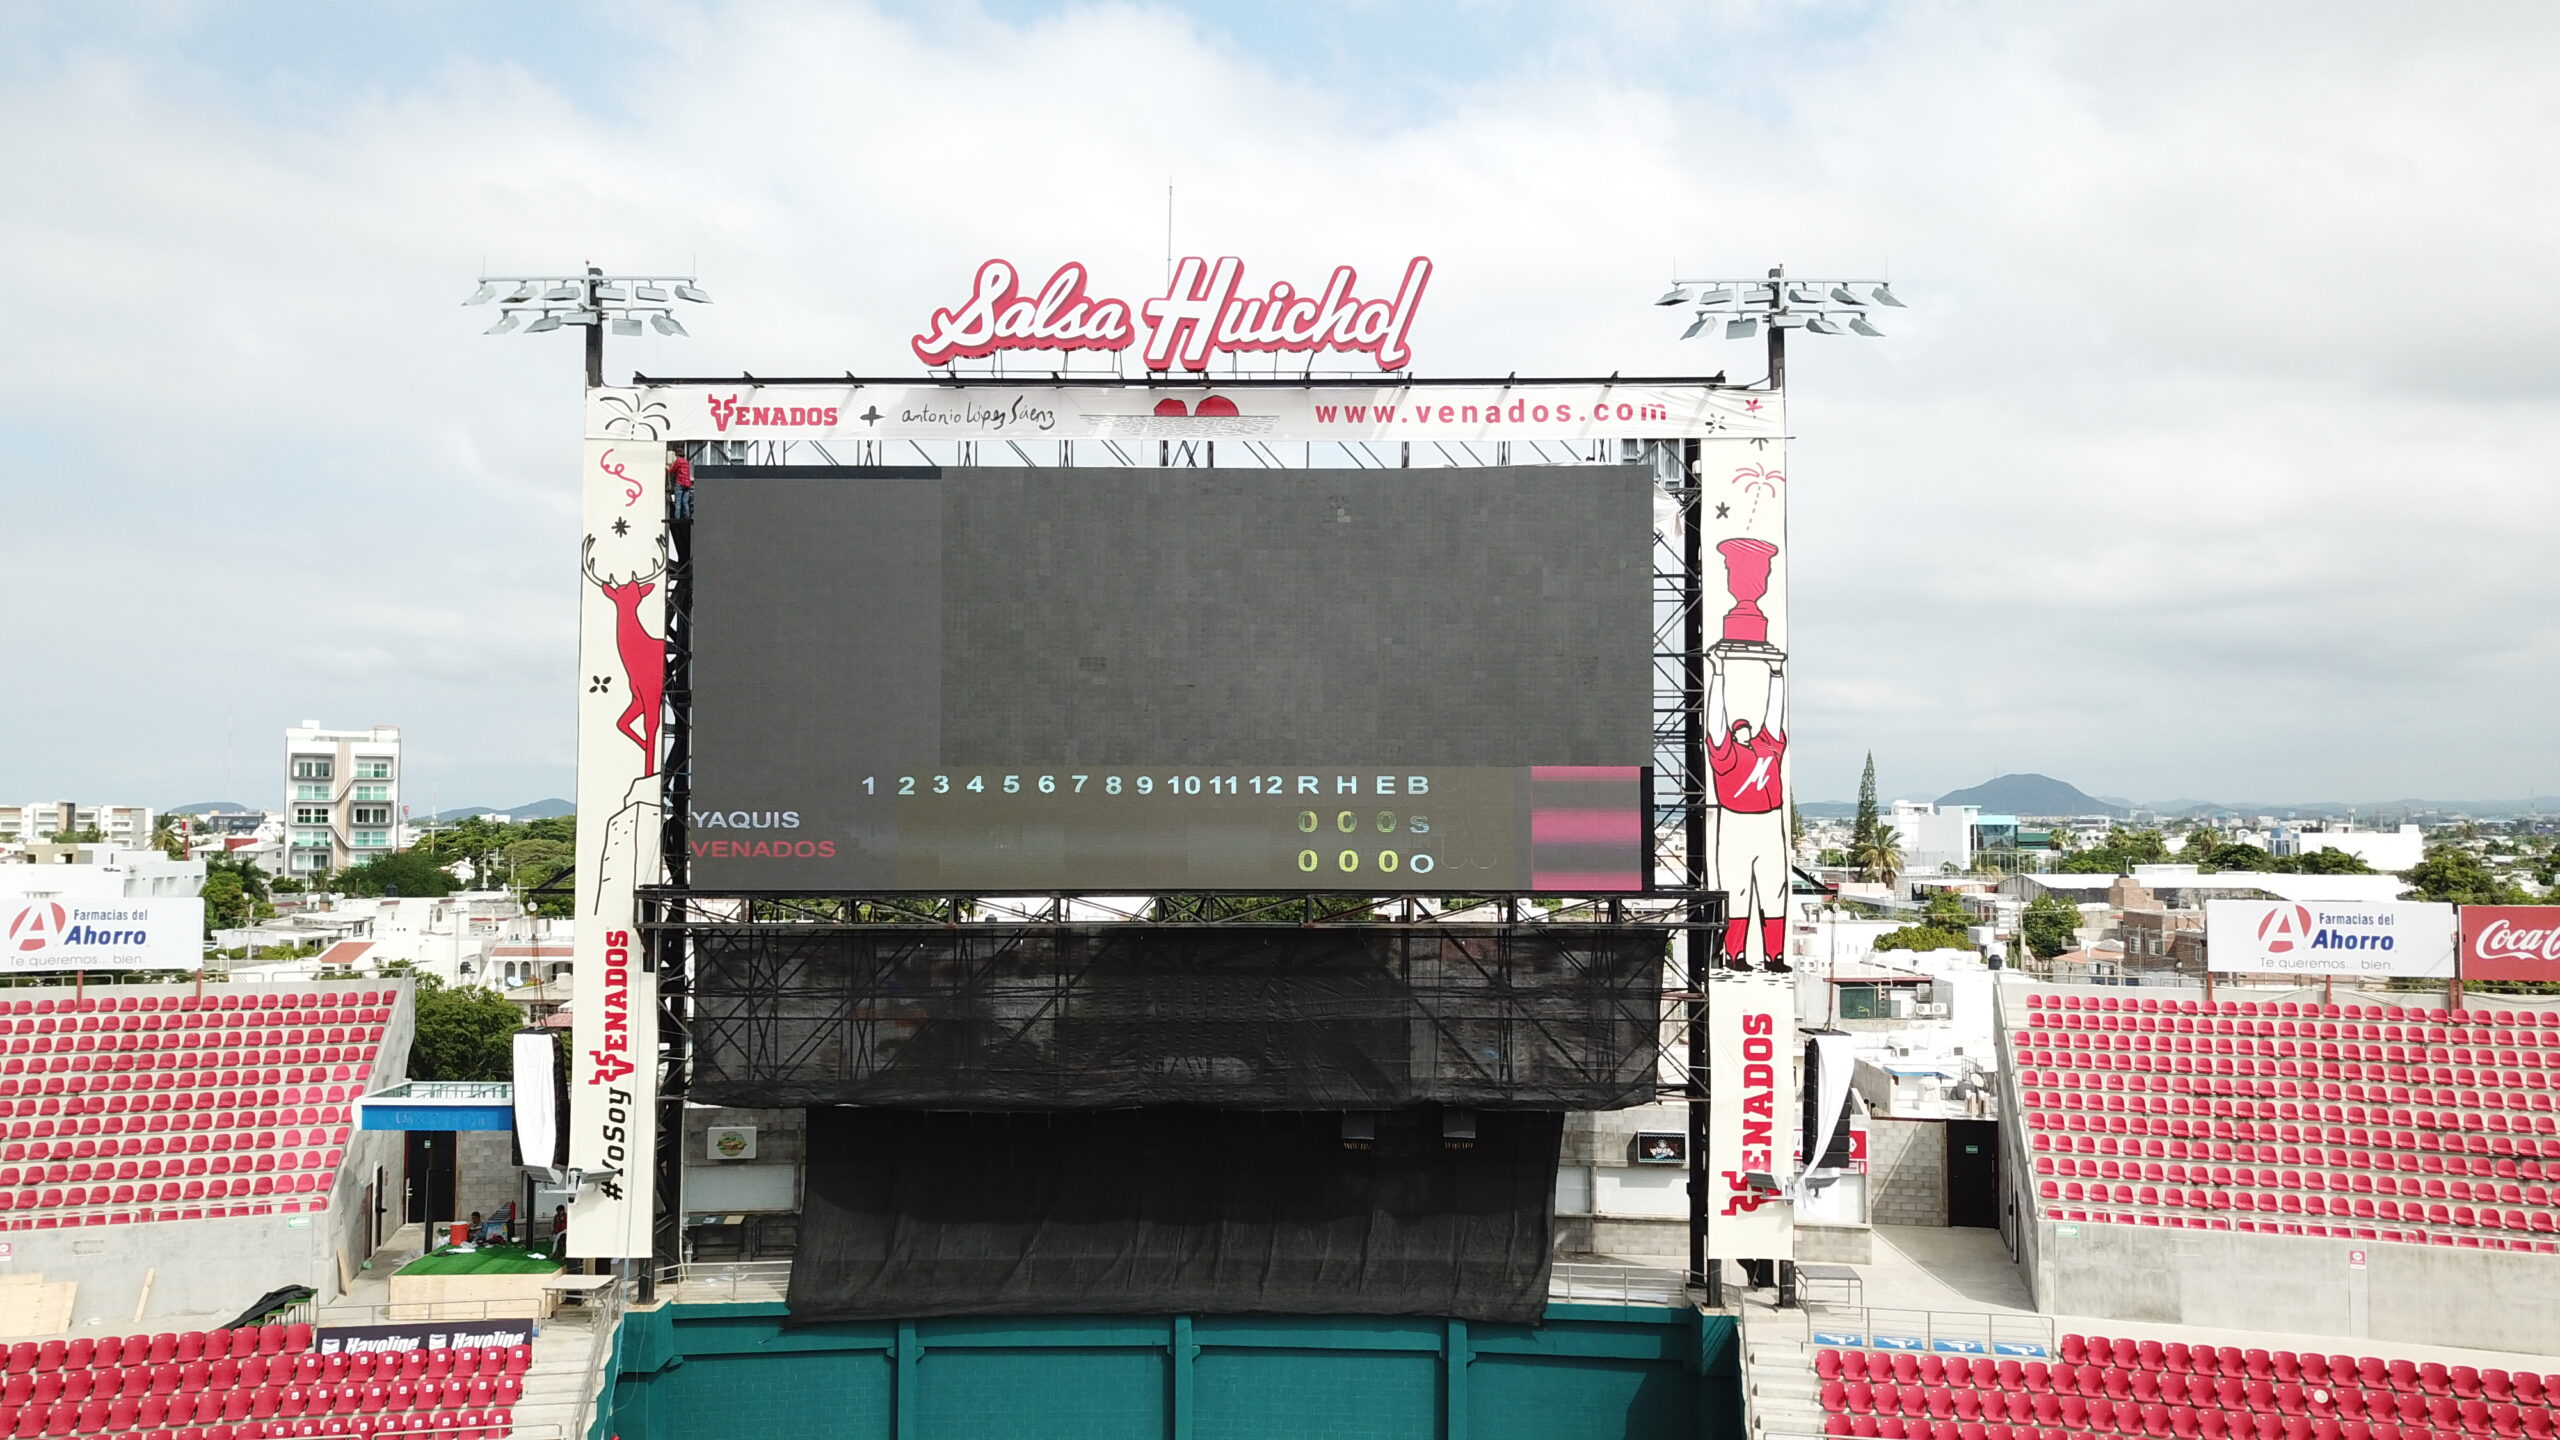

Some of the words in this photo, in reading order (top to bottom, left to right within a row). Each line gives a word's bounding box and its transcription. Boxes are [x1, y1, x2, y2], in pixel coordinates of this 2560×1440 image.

[912, 259, 1134, 367] Salsa
[1142, 256, 1432, 371] Huichol
[708, 393, 838, 431] VENADOS
[902, 403, 961, 425] antonio
[1315, 398, 1668, 424] www.venados.com
[862, 776, 876, 795] 1
[898, 776, 915, 795] 2
[933, 775, 950, 793] 3
[966, 775, 985, 793] 4
[1003, 775, 1020, 793] 5
[1038, 775, 1056, 793] 6
[1071, 775, 1088, 793] 7
[1105, 776, 1122, 794] 8
[1136, 776, 1153, 794] 9
[1167, 776, 1201, 794] 10
[1209, 776, 1239, 794] 11
[1249, 776, 1283, 794] 12
[1297, 776, 1320, 794] R
[1336, 776, 1357, 794] H
[1376, 776, 1396, 794] E
[1407, 776, 1430, 795] B
[691, 811, 800, 829] YAQUIS
[1298, 810, 1318, 833] 0
[1336, 810, 1358, 833] 0
[1409, 815, 1430, 833] S
[690, 840, 837, 858] VENADOS
[1298, 849, 1319, 872] 0
[1338, 849, 1359, 872] 0
[1378, 849, 1399, 872] 0
[73, 909, 128, 921] Farmacias
[132, 909, 148, 921] del
[2319, 912, 2373, 926] Farmacias
[2375, 913, 2394, 925] del
[64, 925, 146, 945] Ahorro
[2311, 929, 2394, 950] Ahorro
[2475, 919, 2560, 960] Coca-C
[9, 955, 25, 967] Te
[113, 953, 146, 965] bien.
[2260, 957, 2275, 967] Te
[2361, 959, 2395, 969] bien.
[588, 930, 634, 1085] VENADOS
[1721, 1013, 1782, 1216] VENADOS
[344, 1335, 422, 1355] Havoline
[451, 1330, 527, 1351] Havoline
